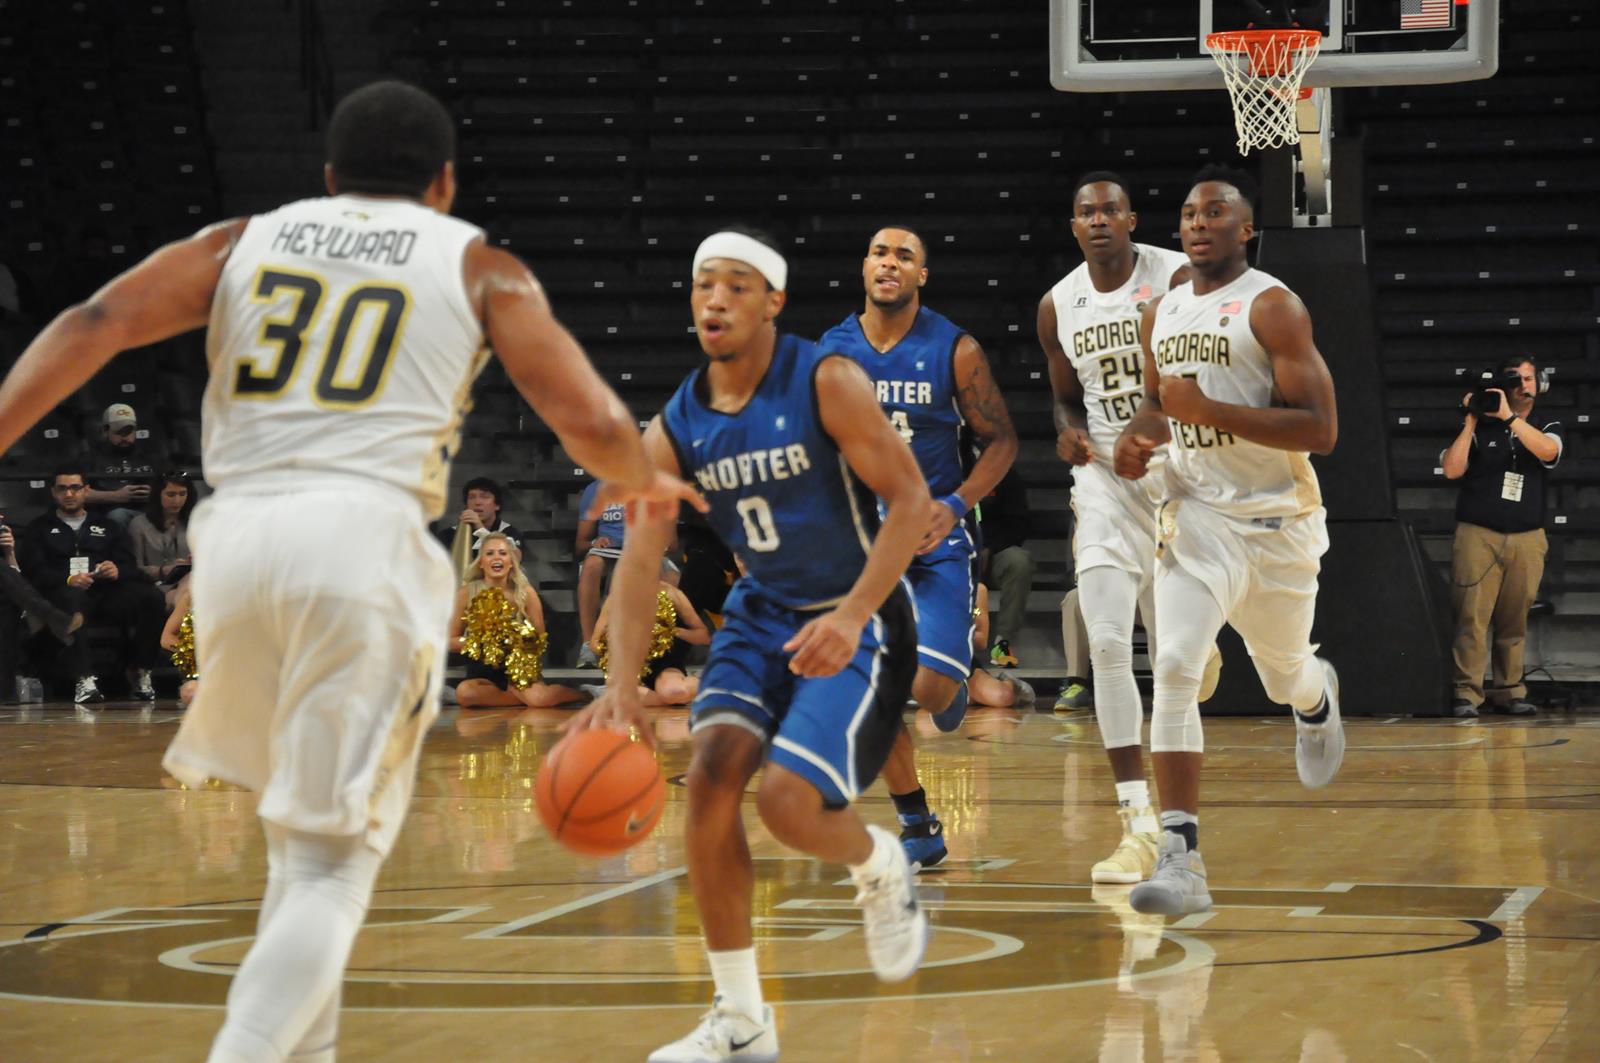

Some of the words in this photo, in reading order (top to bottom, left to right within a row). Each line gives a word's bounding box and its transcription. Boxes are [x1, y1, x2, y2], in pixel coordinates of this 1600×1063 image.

[271, 221, 417, 266] HEYWARD
[234, 265, 414, 411] 30
[1073, 319, 1142, 358] GEORGI
[1157, 333, 1231, 368] GEORGIA
[1098, 352, 1143, 391] 24
[870, 379, 932, 404] RTER
[1098, 392, 1143, 422] TEC
[736, 495, 780, 553] 0
